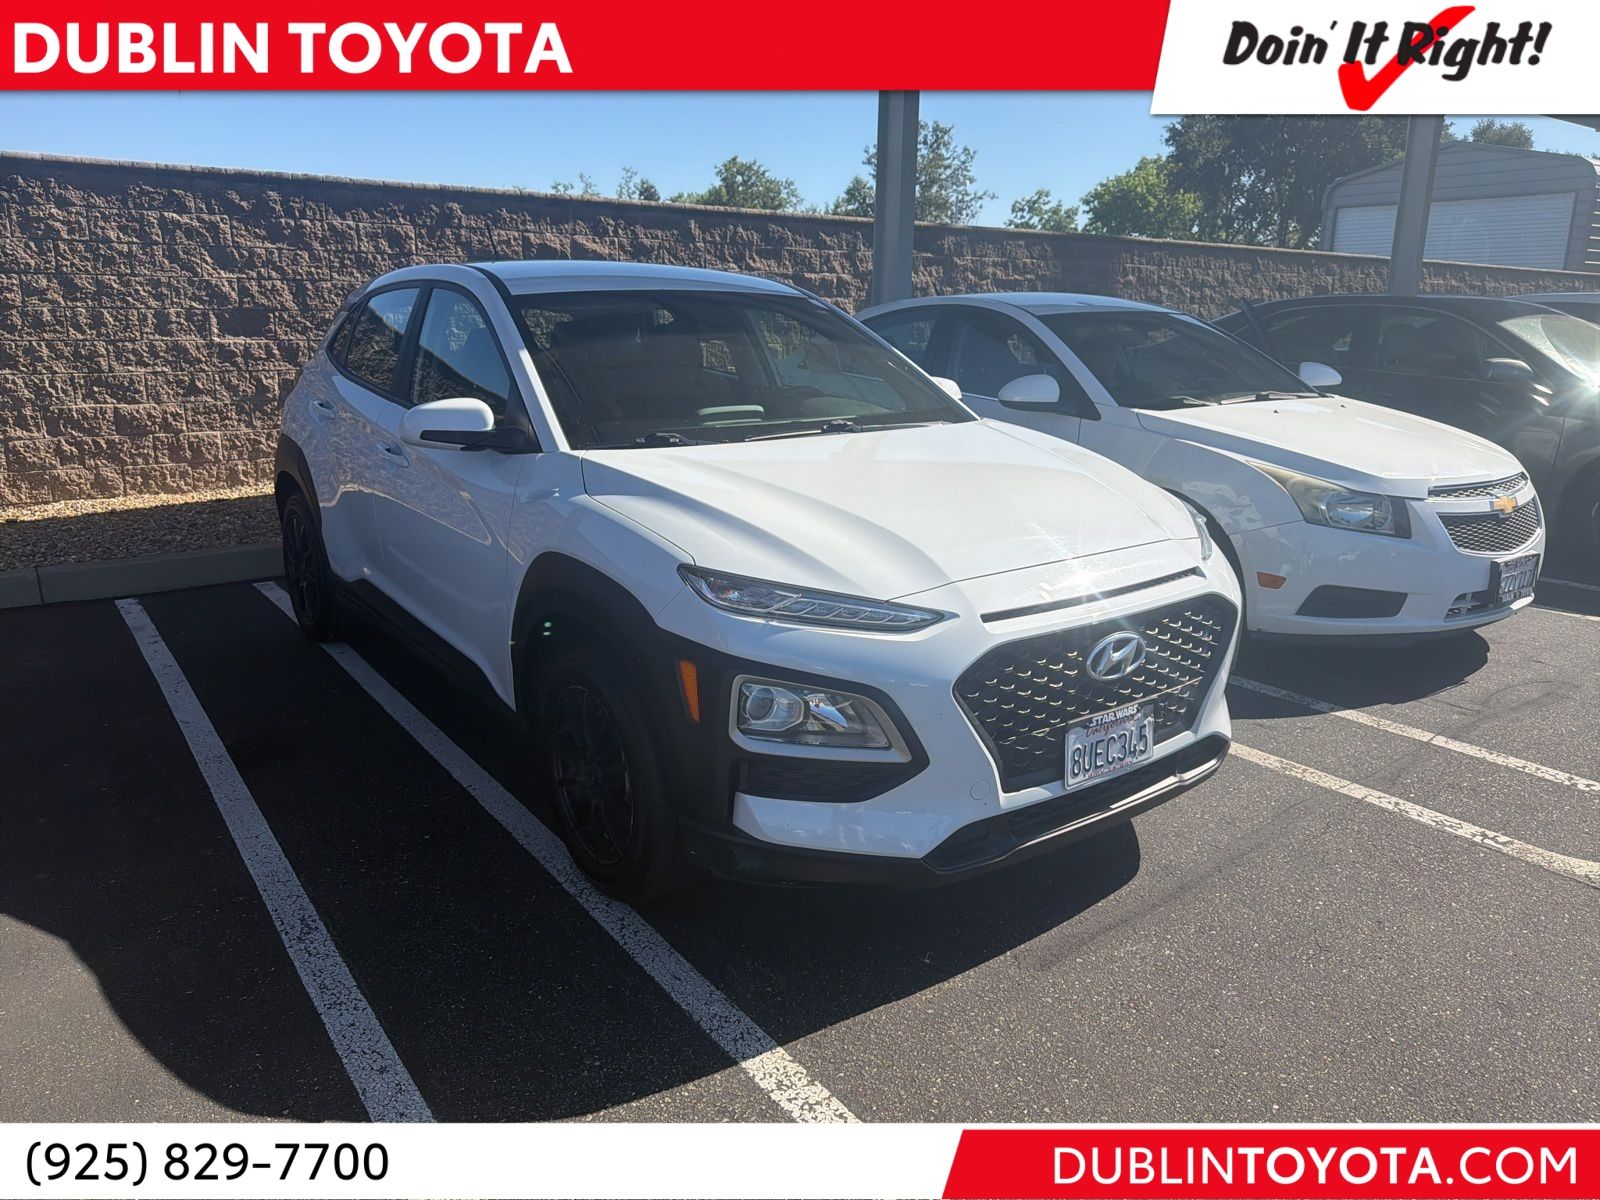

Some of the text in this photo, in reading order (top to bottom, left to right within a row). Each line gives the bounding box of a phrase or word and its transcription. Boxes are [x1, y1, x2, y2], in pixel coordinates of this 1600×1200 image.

[1089, 704, 1139, 728] STAR WARS
[1071, 724, 1149, 778] 8UEC345
